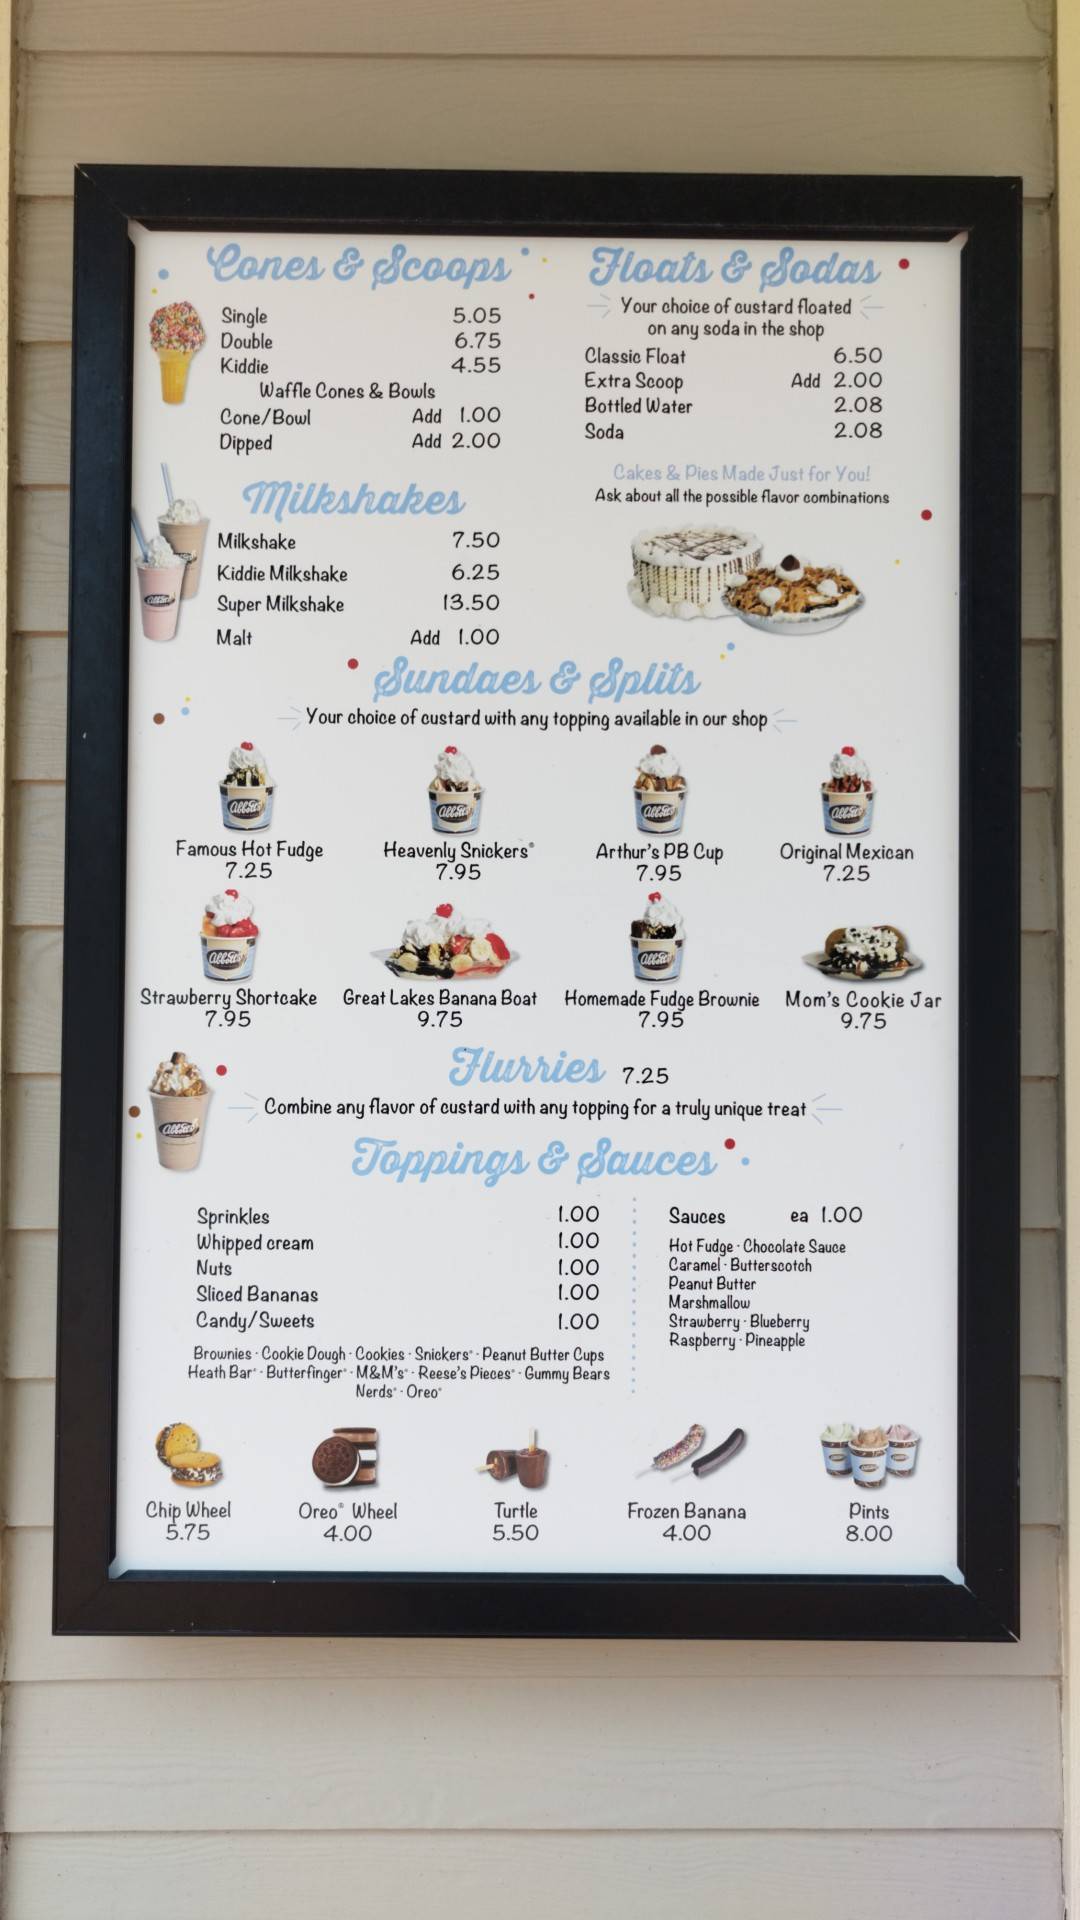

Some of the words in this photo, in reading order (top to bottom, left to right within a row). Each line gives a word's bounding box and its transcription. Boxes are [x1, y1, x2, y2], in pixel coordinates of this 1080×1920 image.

[207, 243, 325, 282] Cones
[333, 246, 364, 281] &
[371, 241, 512, 290] Scoops
[589, 246, 713, 286] Floats
[721, 249, 752, 284] &
[760, 246, 882, 293] Sodas
[222, 307, 267, 328] Single
[453, 307, 501, 324] 5.05
[704, 320, 740, 336] soda
[789, 320, 824, 341] shop
[221, 332, 272, 349] Double
[455, 332, 501, 349] 6.75
[585, 347, 641, 364] Classic
[646, 347, 686, 364] Float
[834, 347, 882, 364] 6.50
[221, 357, 268, 374] Kiddie
[451, 357, 501, 373] 4.55
[585, 371, 630, 388] Extra
[636, 372, 683, 394] Scoop
[791, 373, 820, 388] Add
[834, 372, 882, 388] 2.00
[260, 382, 311, 398] Waffle
[316, 382, 364, 399] Cones
[369, 382, 383, 399] &
[389, 382, 435, 399] Bowls
[585, 396, 641, 413] Bottled
[646, 397, 693, 414] Water
[835, 396, 882, 413] 2.08
[221, 408, 310, 425] Cone/Bowl
[412, 408, 441, 424] Add
[461, 407, 500, 423] 1.00
[585, 422, 624, 440] Soda
[835, 422, 882, 438] 2.08
[220, 433, 272, 455] Dipped
[412, 433, 441, 448] Add
[452, 432, 500, 448] 2.00
[614, 464, 662, 480] Cakes
[666, 464, 680, 480] &
[686, 464, 718, 480] Pies
[723, 465, 764, 481] Made
[769, 465, 803, 481] Just
[809, 465, 831, 482] for
[836, 466, 870, 482] You!
[243, 481, 466, 523] Milkshakes
[595, 488, 621, 502] Ask
[625, 488, 661, 502] about
[665, 488, 679, 502] all
[683, 489, 702, 502] the
[706, 489, 757, 507] possible
[761, 489, 799, 503] flavor
[803, 489, 889, 504] combinations
[218, 533, 295, 550] Milkshake
[453, 531, 500, 548] 7.50
[218, 565, 265, 581] Kiddie
[270, 565, 347, 582] Milkshake
[452, 564, 499, 580] 6.25
[217, 595, 261, 617] Super
[266, 595, 344, 612] Milkshake
[444, 594, 499, 610] 13.50
[217, 629, 252, 646] Malt
[411, 630, 440, 645] Add
[459, 628, 499, 645] 1.00
[373, 656, 542, 703] Sundaes
[549, 660, 581, 695] &
[588, 657, 701, 705] Splits
[176, 840, 237, 856] Famous
[242, 840, 272, 857] Hot
[277, 840, 323, 859] Fudge
[384, 841, 456, 861] Heavenly
[596, 843, 659, 859] Arthur's
[664, 843, 688, 859] PB
[694, 843, 723, 865] Cup
[780, 843, 842, 863] Original
[846, 843, 913, 860] Mexican
[226, 862, 272, 879] 7.25
[436, 863, 481, 880] 7.95
[637, 864, 681, 881] 7.95
[824, 865, 870, 882] 7.25
[141, 988, 231, 1010] Strawberry
[236, 988, 317, 1006] Shortcake
[343, 988, 385, 1005] Great
[390, 989, 434, 1006] Lakes
[439, 989, 496, 1006] Banana
[501, 989, 537, 1006] Boat
[565, 989, 645, 1006] Homemade
[650, 990, 694, 1012] Fudge
[699, 990, 759, 1007] Brownie
[786, 990, 840, 1007] Mom's
[846, 991, 904, 1008] Cookie
[911, 991, 941, 1008] Jar
[206, 1010, 251, 1027] 7.95
[418, 1011, 462, 1027] 9.75
[639, 1010, 684, 1028] 7.95
[841, 1012, 886, 1029] 9.75
[449, 1047, 607, 1086] Flurries
[623, 1067, 668, 1084] 7.25
[352, 1137, 530, 1187] Toppings
[538, 1140, 569, 1175] &
[576, 1137, 718, 1184] Sauces
[198, 1207, 269, 1228] Sprinkles
[559, 1205, 599, 1222] 1.00
[669, 1207, 725, 1224] Sauces
[791, 1211, 808, 1223] ea
[822, 1206, 862, 1223] 1.00
[197, 1233, 262, 1255] Whipped
[267, 1239, 313, 1251] cream
[559, 1232, 599, 1248] 1.00
[669, 1238, 692, 1252] Hot
[697, 1238, 733, 1257] Fudge
[743, 1238, 805, 1253] Chocolate
[809, 1239, 846, 1253] Sauce
[197, 1259, 232, 1276] Nuts
[559, 1259, 599, 1275] 1.00
[669, 1257, 720, 1272] Caramel
[731, 1257, 812, 1272] Butterscotch
[669, 1275, 713, 1290] Peanut
[717, 1276, 756, 1290] Butter
[197, 1285, 242, 1302] Sliced
[248, 1285, 318, 1302] Bananas
[559, 1284, 599, 1300] 1.00
[669, 1294, 750, 1309] Marshmallow
[196, 1310, 314, 1333] Candy/Sweets
[559, 1313, 599, 1330] 1.00
[669, 1313, 740, 1332] Strawberry
[750, 1313, 809, 1332] Blueberry
[669, 1332, 735, 1351] Raspberry
[746, 1332, 805, 1351] Pineapple
[194, 1346, 251, 1360] Brownies
[262, 1345, 304, 1360] Cookie
[308, 1346, 345, 1364] Dough
[356, 1346, 404, 1361] Cookies
[483, 1346, 526, 1361] Peanut
[530, 1347, 570, 1361] Butter
[574, 1347, 604, 1365] Cups
[188, 1365, 225, 1379] Heath
[418, 1365, 466, 1380] Reese's
[525, 1366, 569, 1384] Gummy
[573, 1366, 610, 1380] Bears
[146, 1501, 181, 1523] Chip
[186, 1501, 231, 1518] Wheel
[352, 1502, 397, 1519] Wheel
[494, 1502, 537, 1518] Turtle
[628, 1502, 679, 1519] Frozen
[685, 1502, 746, 1519] Banana
[850, 1502, 889, 1519] Pints
[166, 1522, 210, 1541] 5.75
[323, 1525, 372, 1542] 4.00
[493, 1524, 539, 1541] 5.50
[663, 1524, 711, 1541] 4.00
[846, 1525, 892, 1542] 8.00
